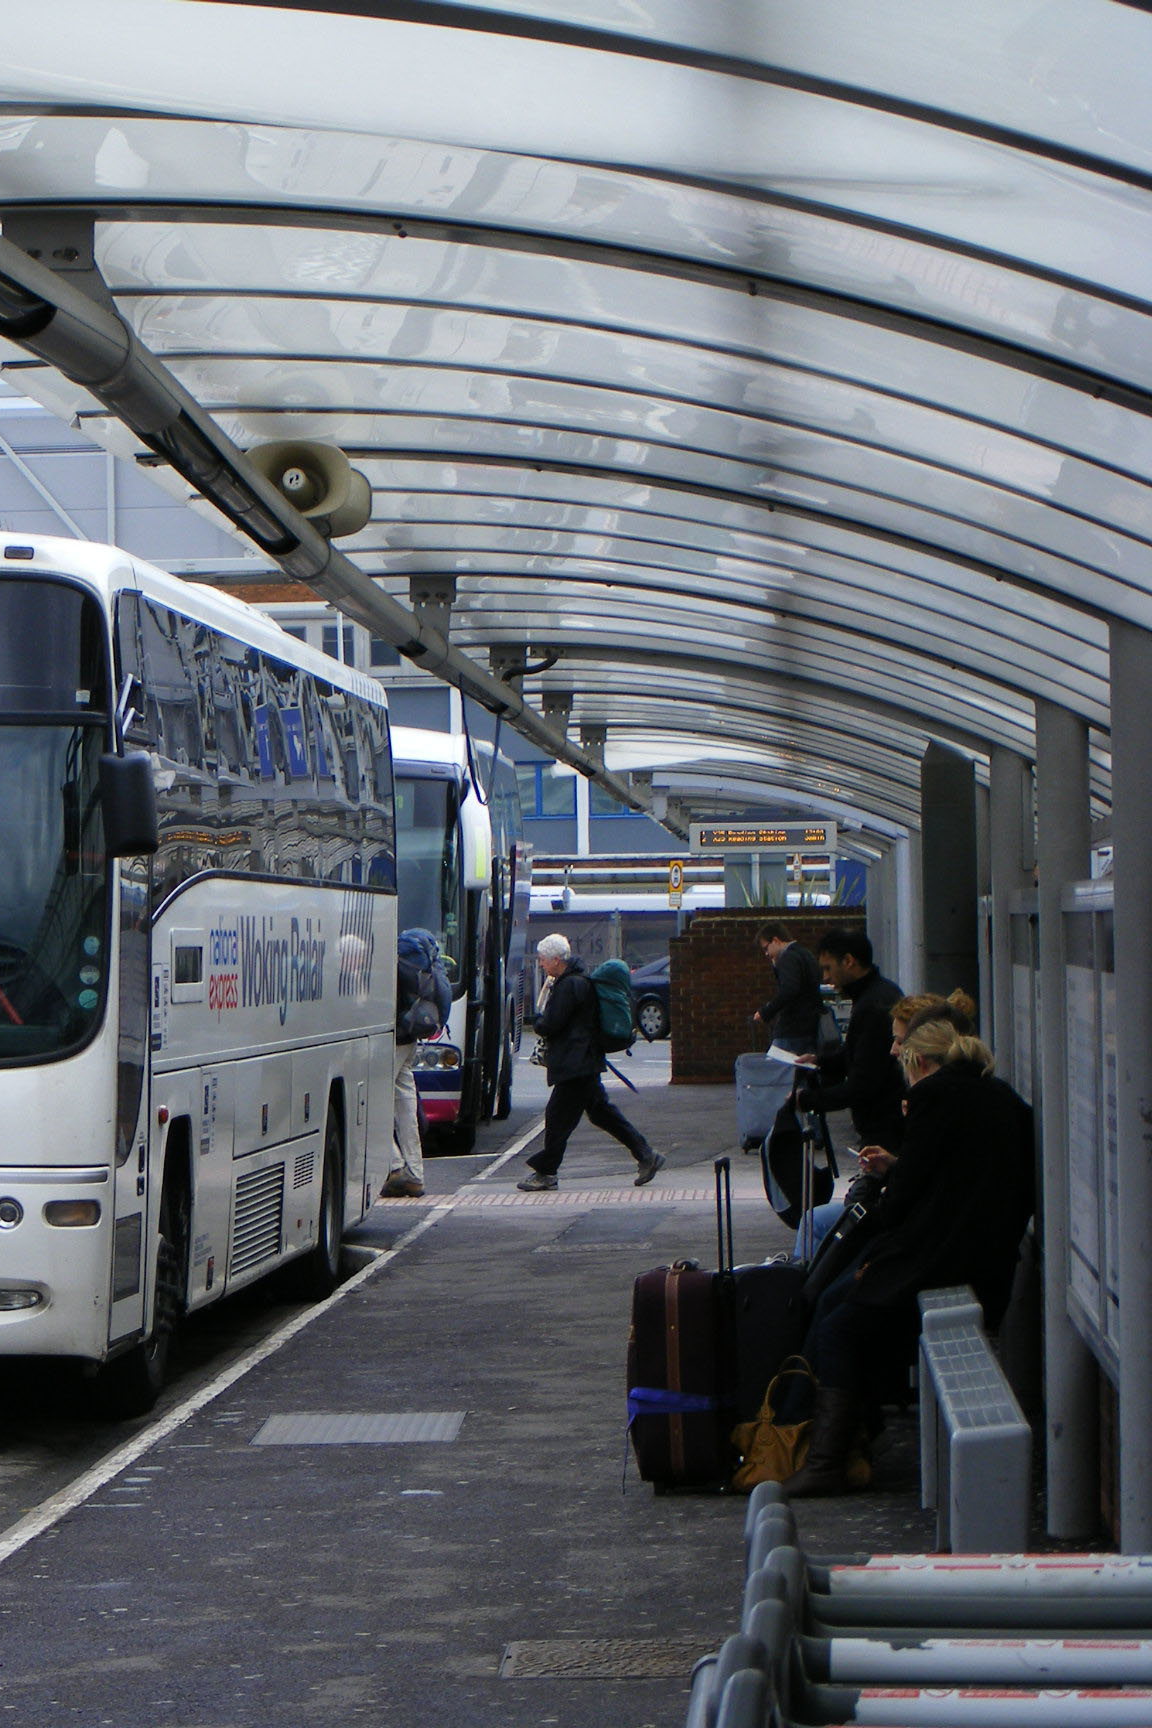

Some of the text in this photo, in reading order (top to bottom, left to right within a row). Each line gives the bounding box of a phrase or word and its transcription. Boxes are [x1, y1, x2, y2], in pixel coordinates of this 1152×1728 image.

[210, 914, 239, 966] national
[240, 915, 288, 1026] Woking
[290, 917, 326, 1003] Railair
[209, 973, 239, 1025] express
